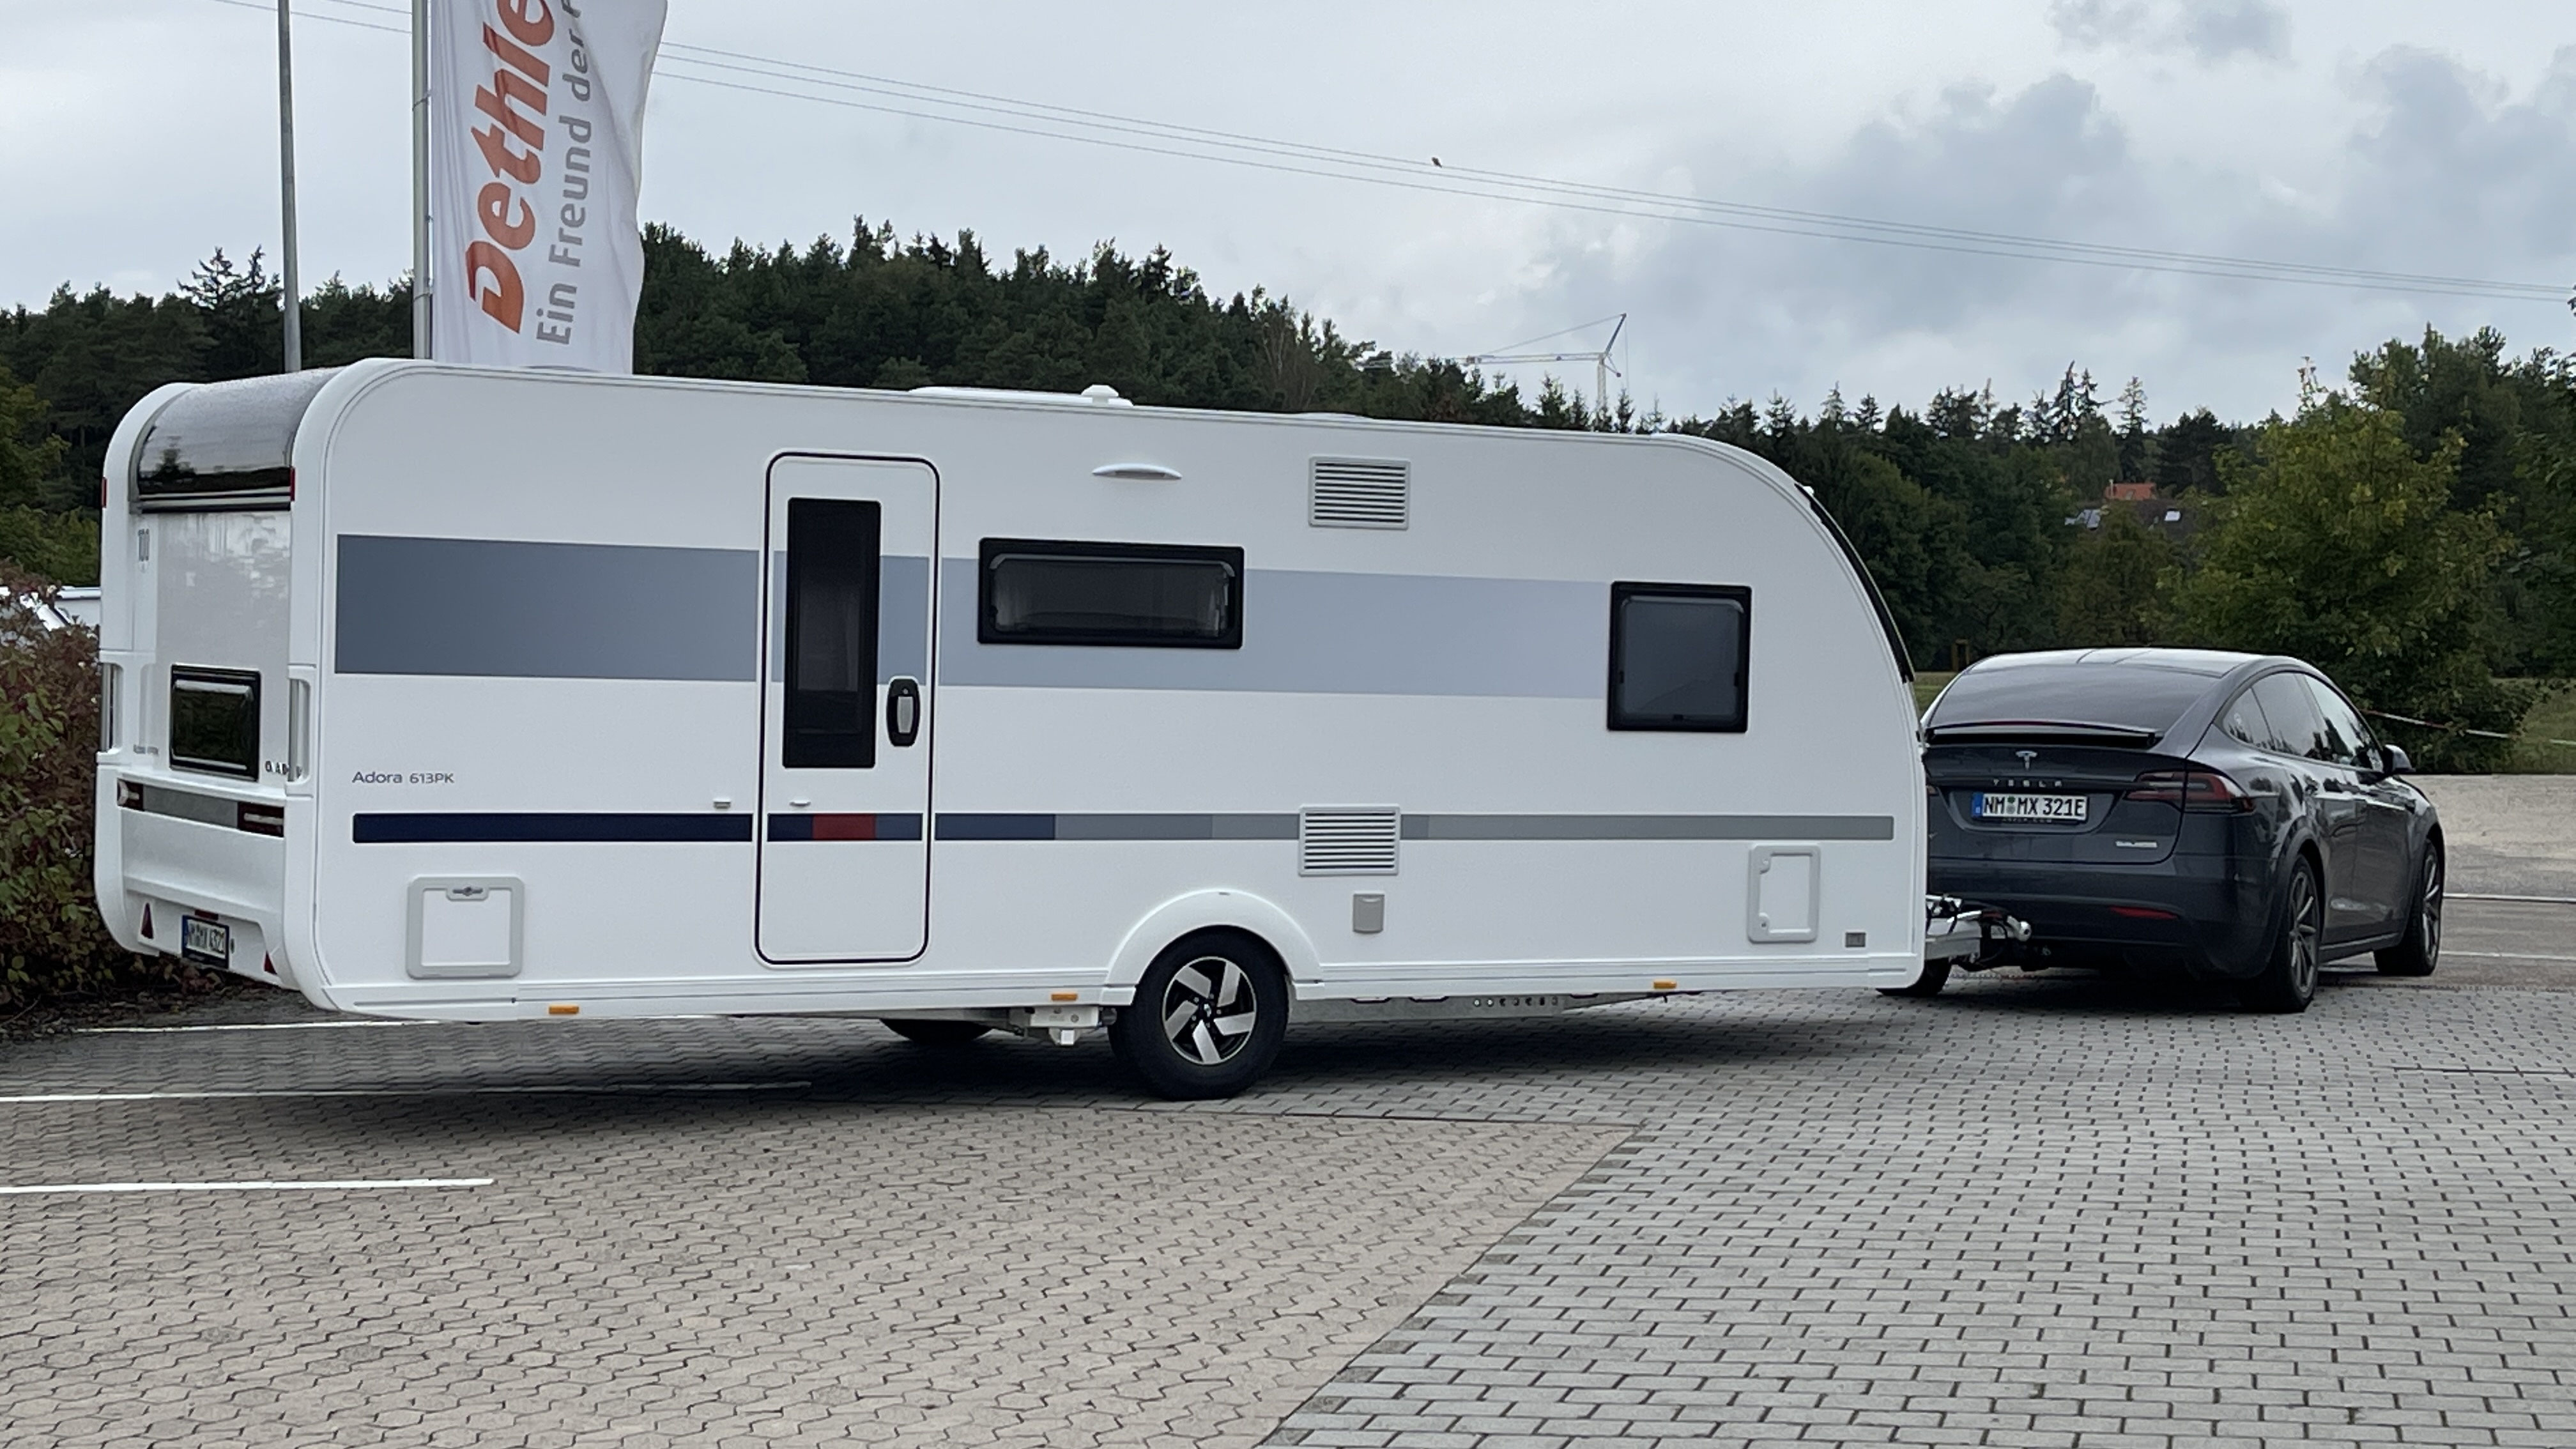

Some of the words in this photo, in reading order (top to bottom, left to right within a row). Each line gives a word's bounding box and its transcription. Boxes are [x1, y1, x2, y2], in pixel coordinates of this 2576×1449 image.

[562, 28, 590, 102] der
[548, 115, 592, 267] Freund
[536, 283, 578, 345] Ein
[352, 771, 402, 783] Adora
[410, 772, 454, 783] 613PK
[2043, 798, 2085, 817] 321E
